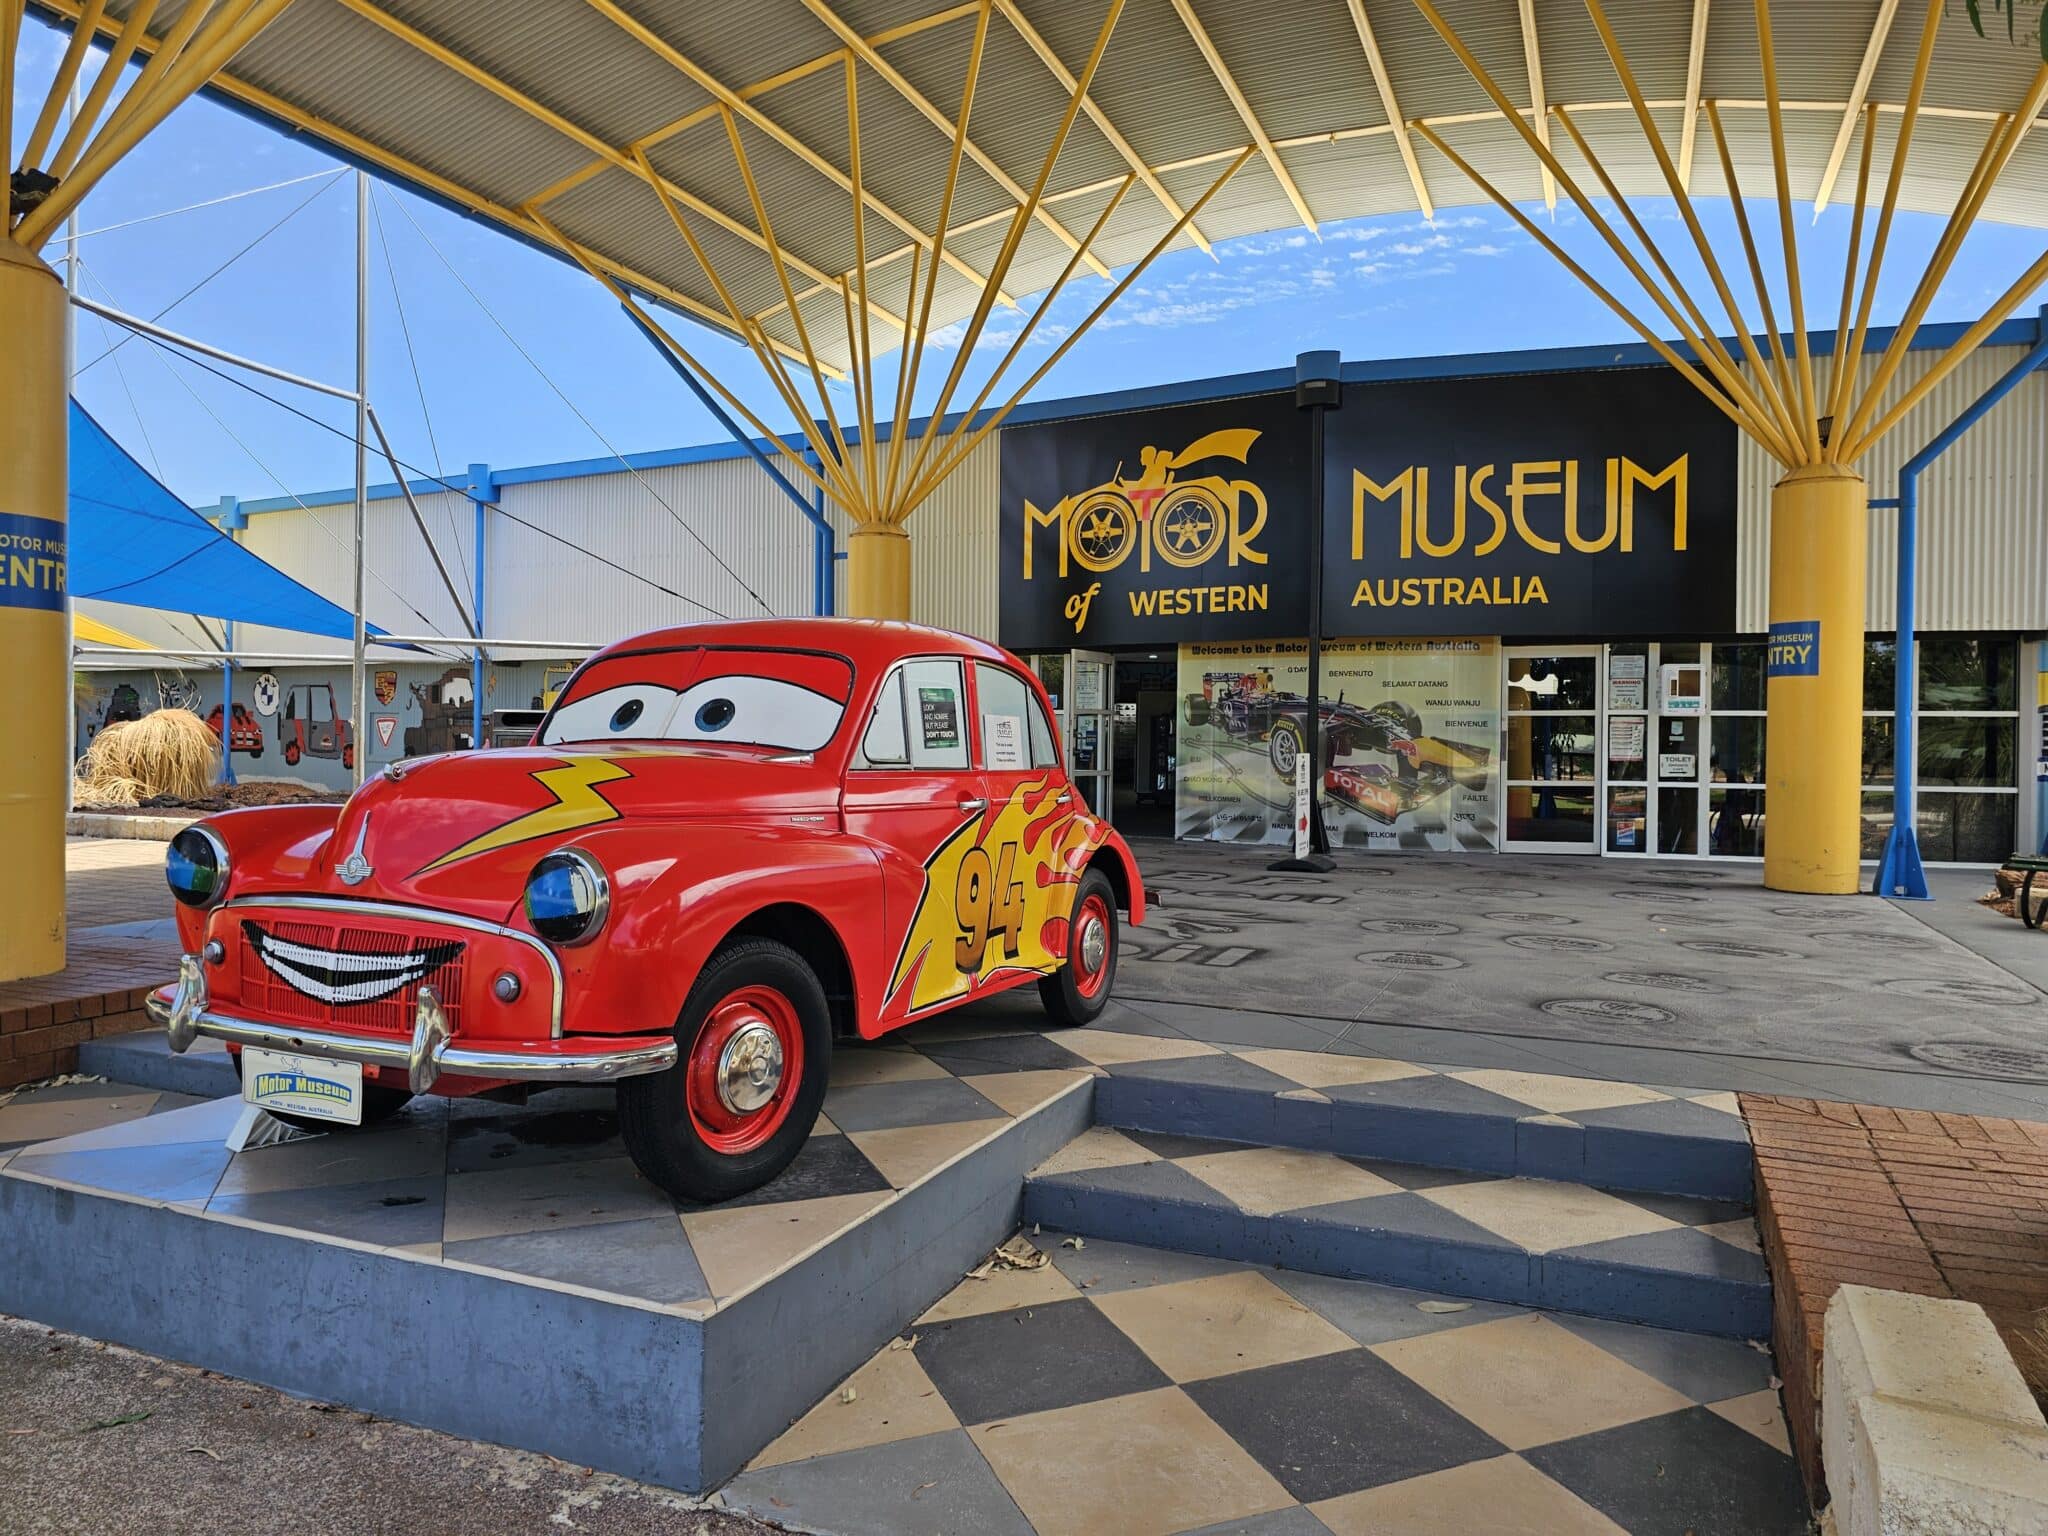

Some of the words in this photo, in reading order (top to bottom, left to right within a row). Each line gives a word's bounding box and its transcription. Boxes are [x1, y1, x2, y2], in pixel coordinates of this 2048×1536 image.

[1023, 480, 1268, 580] MOTOR
[1351, 452, 1688, 560] MUSEUM
[0, 534, 42, 551] OTOR
[46, 539, 67, 556] MUS
[0, 554, 66, 593] NTR
[1064, 582, 1101, 634] of
[1128, 583, 1268, 617] WESTERN
[1351, 576, 1549, 607] AUSTRALIA
[1192, 645, 1239, 655] Welcome
[1242, 644, 1252, 654] to
[1256, 644, 1272, 654] the
[1276, 643, 1307, 654] Motor
[1320, 642, 1356, 651] useum
[1360, 641, 1372, 651] of
[1776, 633, 1813, 643] MUSEUM
[1768, 645, 1812, 666] NTRY
[1382, 680, 1416, 688] SELAMAT
[1418, 680, 1448, 688] DATANG
[1445, 720, 1488, 728] BIENVENUE
[1329, 769, 1391, 807] TOTAL
[955, 841, 1026, 974] 94
[258, 1075, 292, 1097] Motor
[295, 1076, 350, 1100] Museum
